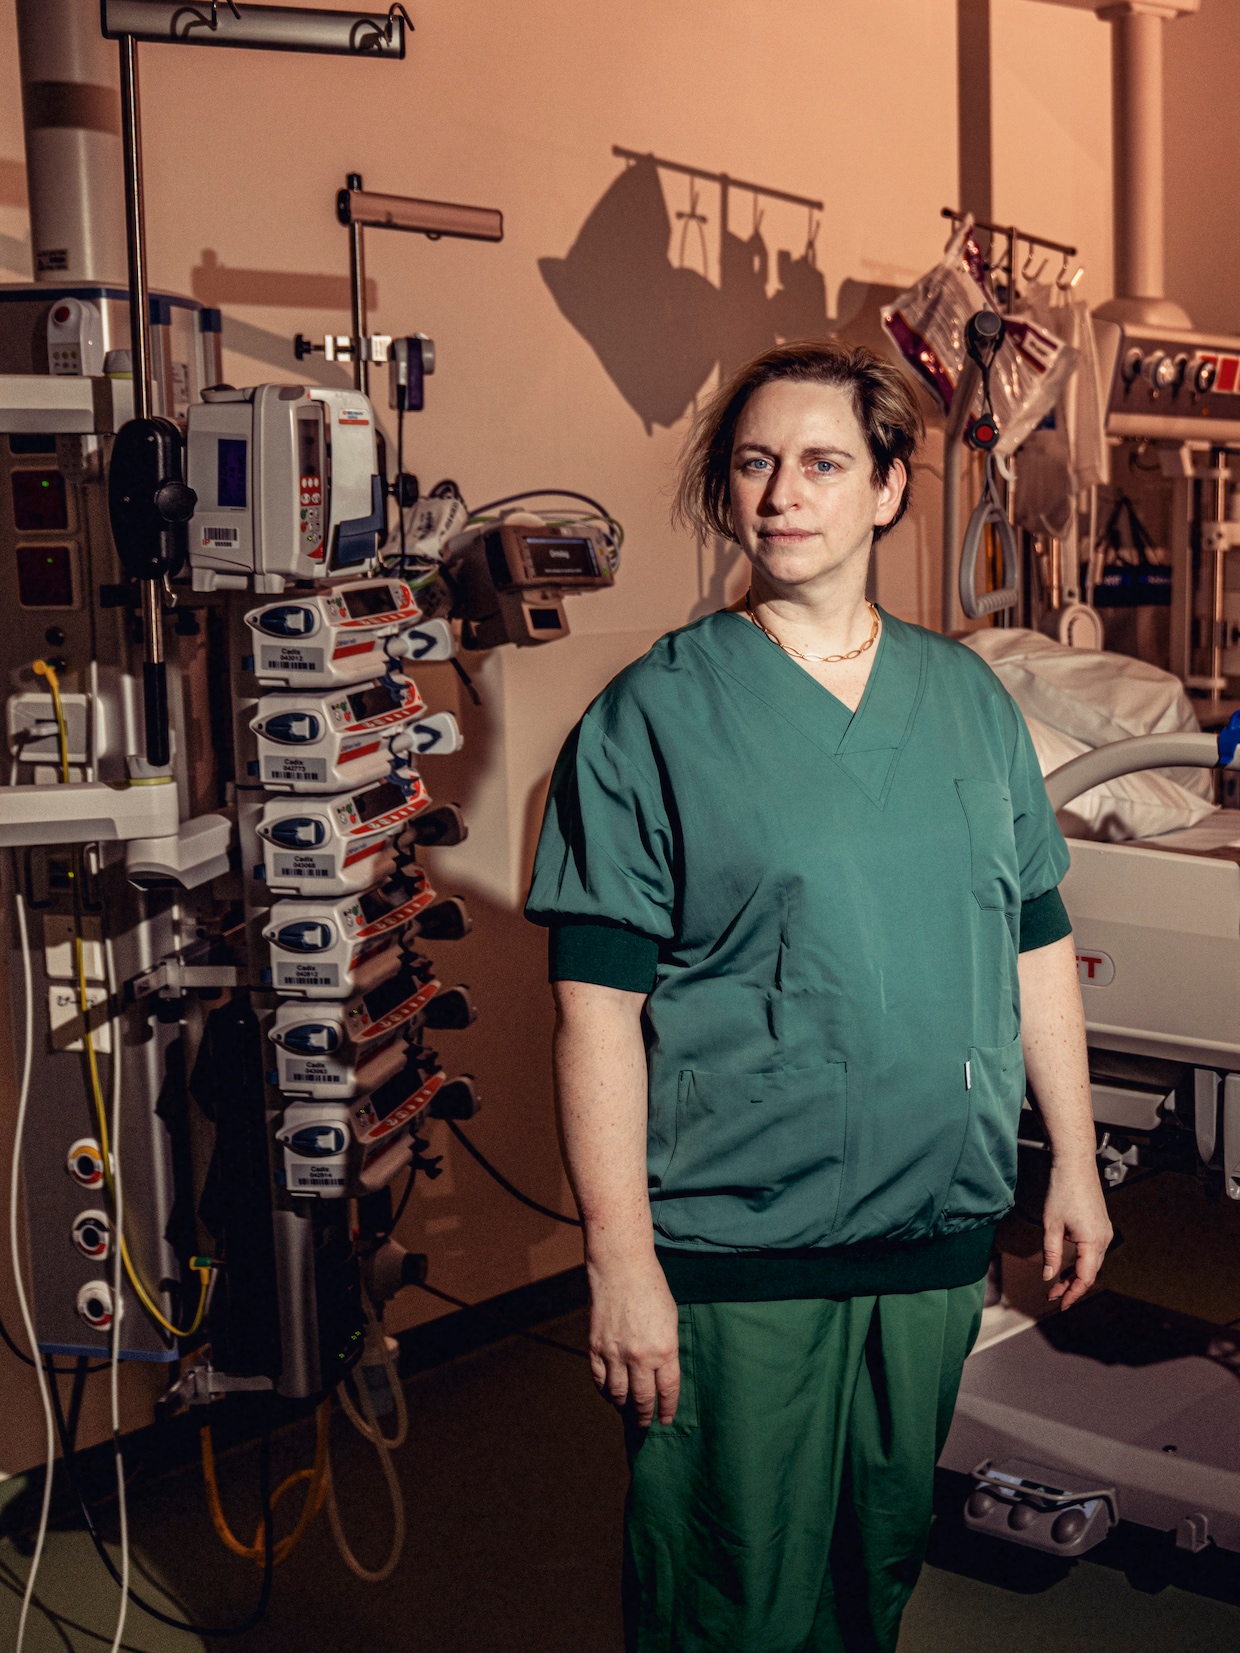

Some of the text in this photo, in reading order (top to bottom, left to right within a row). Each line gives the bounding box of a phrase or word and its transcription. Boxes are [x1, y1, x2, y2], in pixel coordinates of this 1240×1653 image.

[284, 758, 303, 766] Cadix
[294, 855, 313, 863] Cadix
[310, 1165, 329, 1173] Cadix
